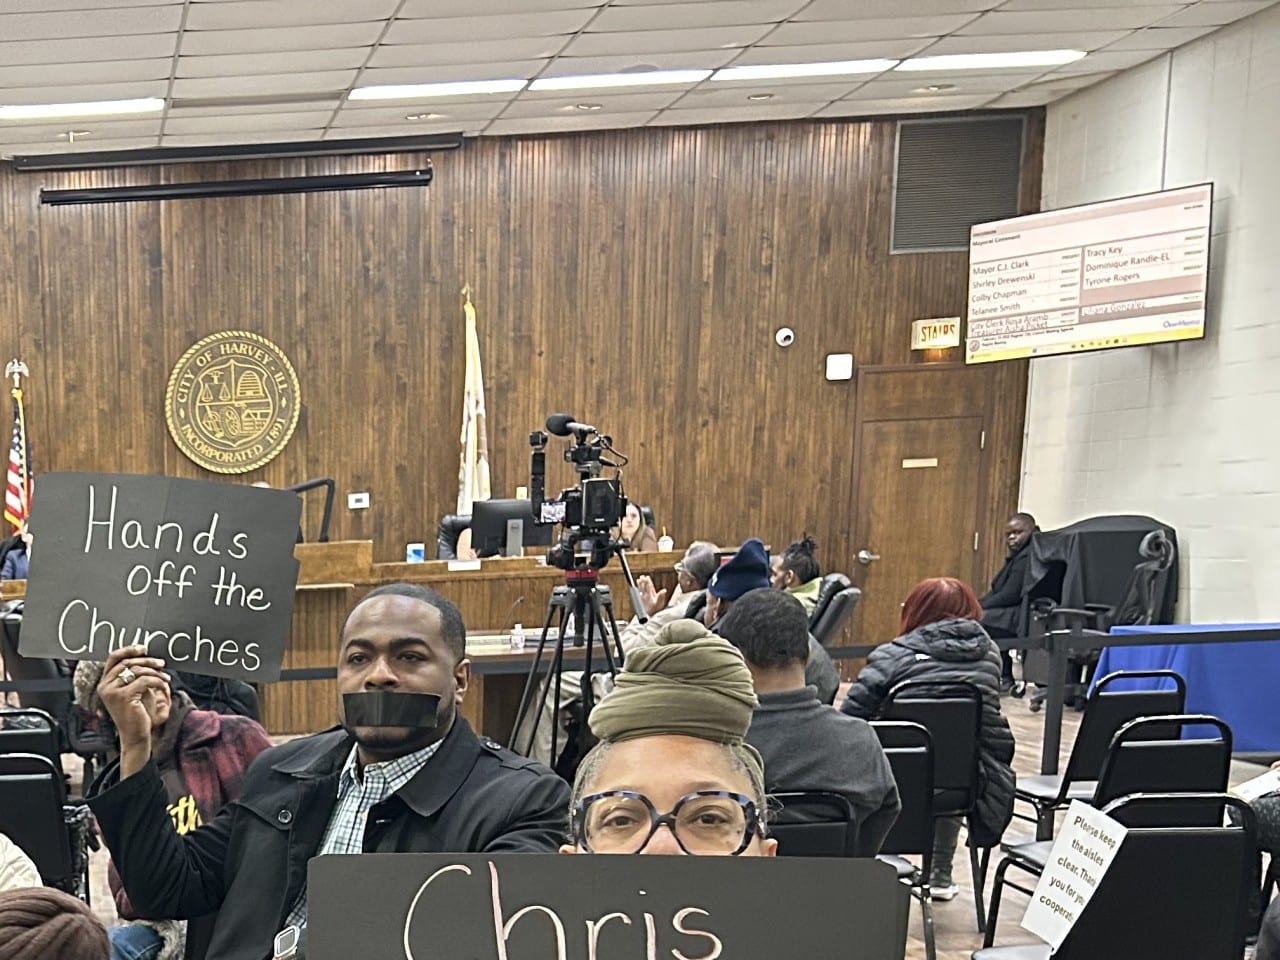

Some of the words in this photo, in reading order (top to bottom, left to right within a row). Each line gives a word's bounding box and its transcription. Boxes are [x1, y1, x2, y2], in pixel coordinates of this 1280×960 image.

[1086, 249, 1107, 258] Tracy
[1108, 246, 1123, 254] Key
[972, 266, 996, 275] Mayor
[1010, 260, 1029, 269] Clark
[1085, 258, 1129, 272] Dominique
[972, 279, 996, 289] Shirley
[997, 273, 1036, 286] Drewenski
[1085, 276, 1112, 287] Tyrone
[1113, 273, 1140, 283] Rogers
[971, 293, 992, 303] Colby
[992, 289, 1027, 300] Chapman
[999, 302, 1021, 312] Smith
[177, 369, 195, 403] CITY
[196, 350, 213, 368] OF
[220, 342, 273, 366] HARVEY
[273, 370, 288, 394] ILL
[181, 423, 264, 463] INCORPORATED
[265, 417, 287, 444] 1891
[84, 484, 249, 560] Hands
[210, 565, 272, 612] the
[58, 599, 261, 671] Churches
[1073, 815, 1100, 839] Please
[1098, 829, 1117, 850] keep
[1072, 838, 1083, 854] the
[1083, 847, 1104, 867] aisles
[1057, 856, 1079, 876] clear.
[1048, 875, 1066, 892] you
[1065, 884, 1077, 898] for
